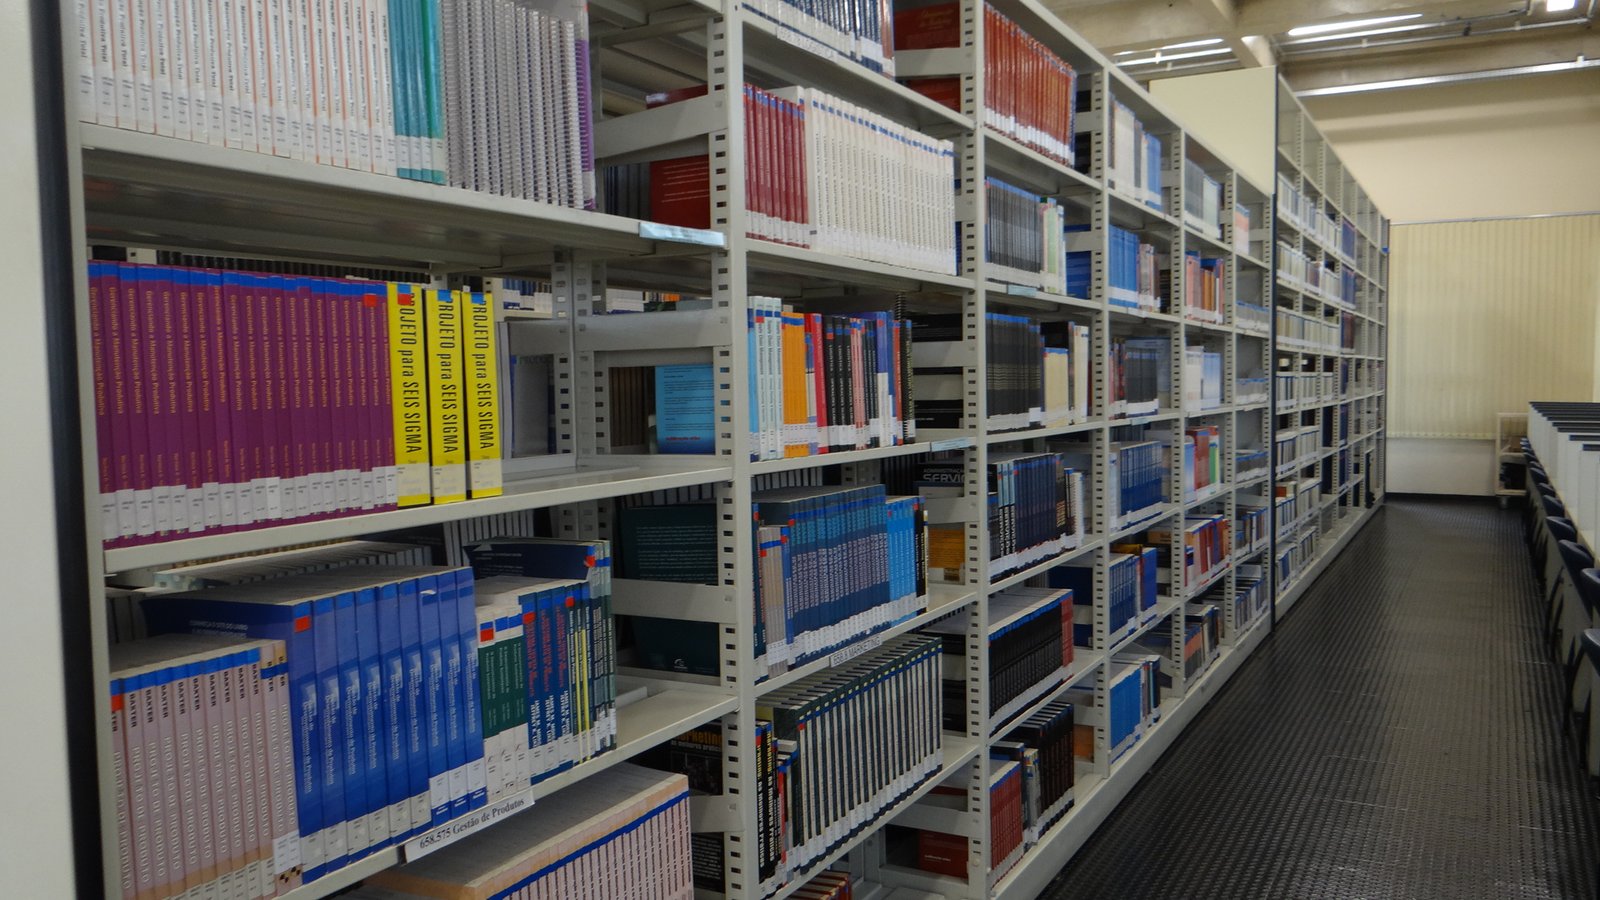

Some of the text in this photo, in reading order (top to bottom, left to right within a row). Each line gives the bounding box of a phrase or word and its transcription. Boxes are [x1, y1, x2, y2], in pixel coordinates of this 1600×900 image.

[397, 350, 414, 377] para
[436, 300, 458, 453] ROJETO para SEIS SIGMA
[472, 300, 494, 449] ROJETO para SEIS SIGMA
[403, 382, 419, 408] SEIS
[404, 413, 422, 453] SIGMA
[161, 685, 169, 718] BAXTER
[169, 813, 181, 870] PRODUTO
[178, 681, 186, 714] BAXTER
[185, 809, 197, 865] PRODUTO
[209, 674, 217, 707] BAXTER
[217, 799, 228, 853] PRODUTO
[238, 667, 246, 699] BAXTER
[246, 789, 256, 842] PRODUTO
[129, 693, 138, 728] BAXTER
[138, 825, 150, 883] PRODUTO
[145, 689, 154, 723] BAXTER
[154, 819, 166, 877] PRODUTO
[259, 783, 270, 836] PRODUTO
[274, 779, 284, 832] PRODUTO
[286, 773, 296, 825] PRODUTO
[201, 803, 212, 858] PRODUTO
[231, 793, 242, 848] PRODUTO
[420, 799, 524, 848] 658.575 Gestão de Produtos
[119, 831, 131, 889] PRODUTO
